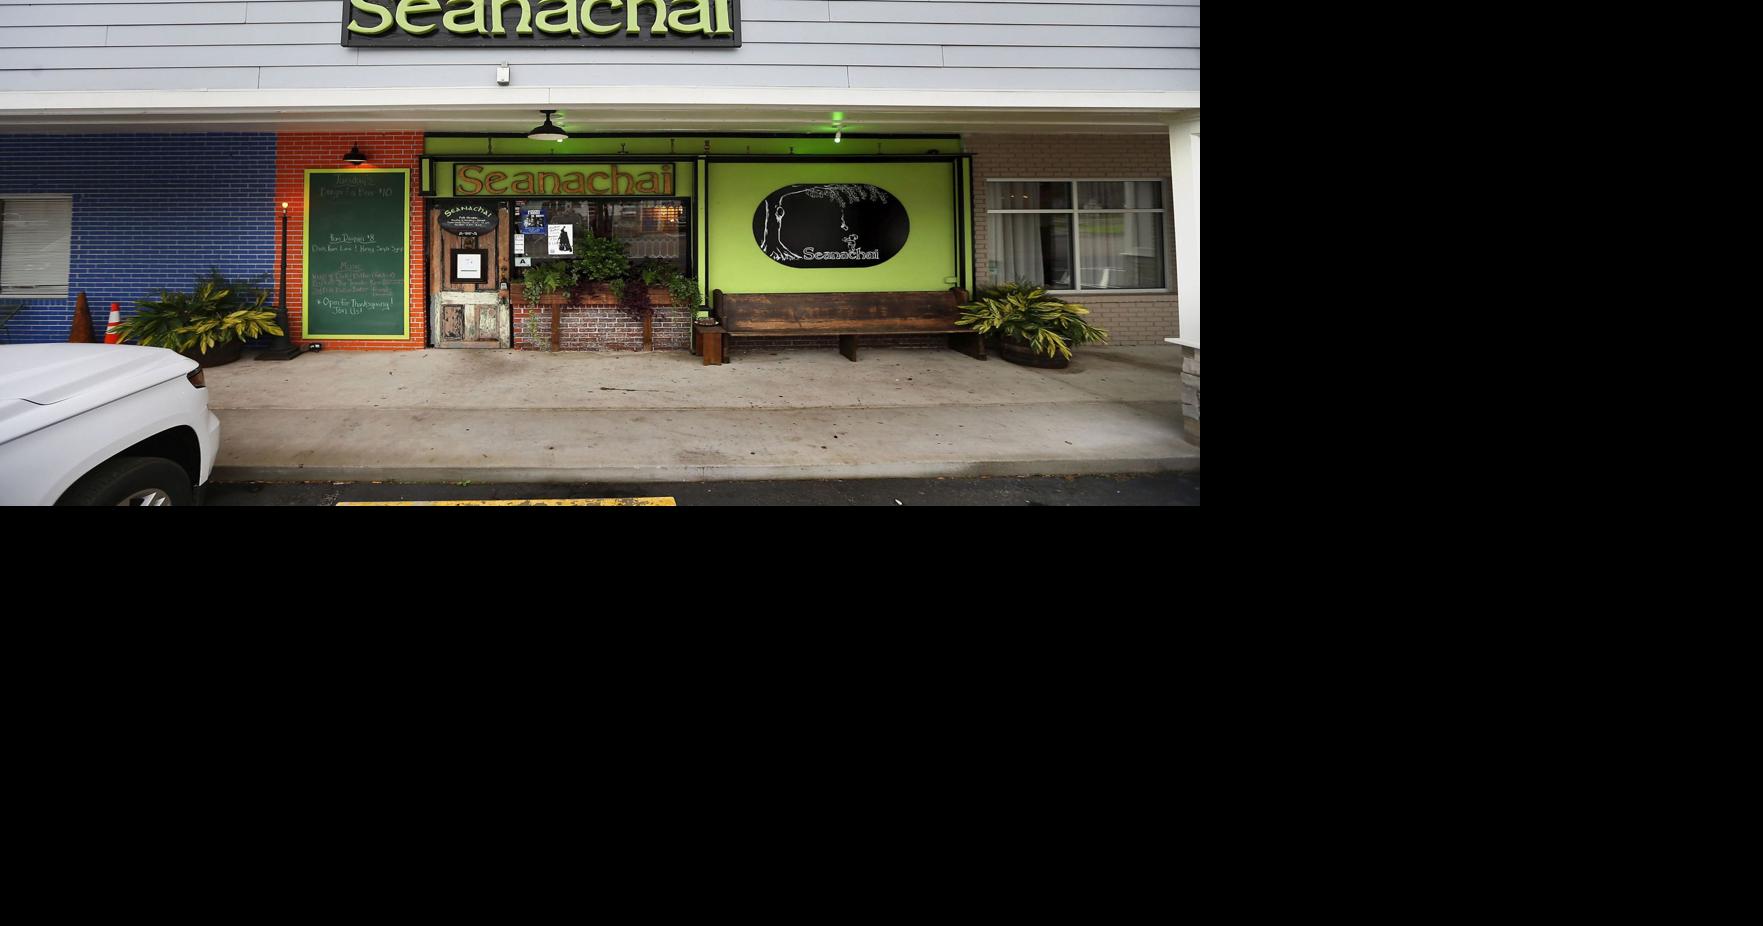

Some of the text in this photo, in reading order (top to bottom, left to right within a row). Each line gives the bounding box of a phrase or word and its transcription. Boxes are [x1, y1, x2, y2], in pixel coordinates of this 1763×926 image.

[456, 164, 673, 195] Seanachai
[802, 247, 879, 260] Seanachai
[323, 297, 340, 308] Open
